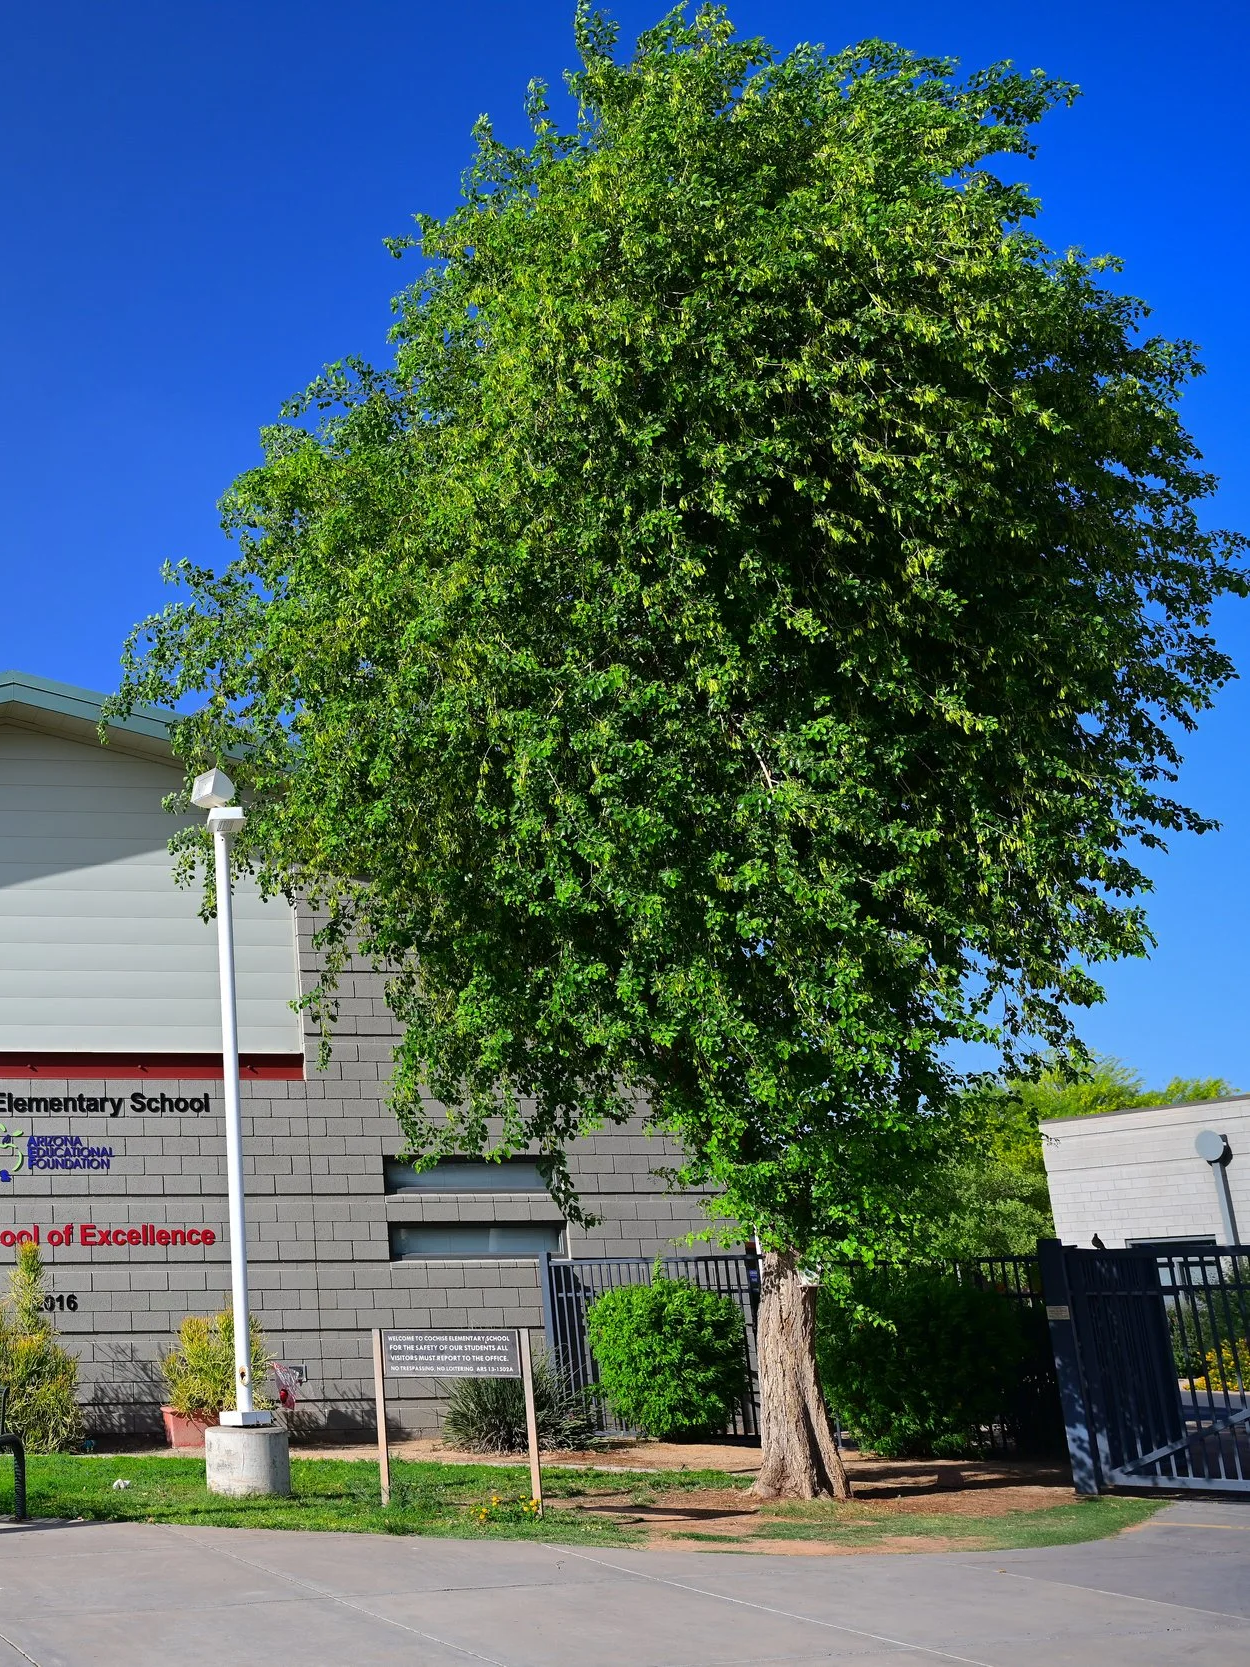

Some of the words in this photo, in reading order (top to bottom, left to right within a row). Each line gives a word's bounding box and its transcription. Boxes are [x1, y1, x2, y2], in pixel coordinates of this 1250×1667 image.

[130, 1092, 211, 1113] School
[28, 1136, 83, 1147] ARIZONA
[28, 1147, 115, 1158] EDUCATIONAL
[28, 1158, 110, 1169] FOUNDATION
[47, 1224, 74, 1246] of
[80, 1224, 216, 1246] Excellence
